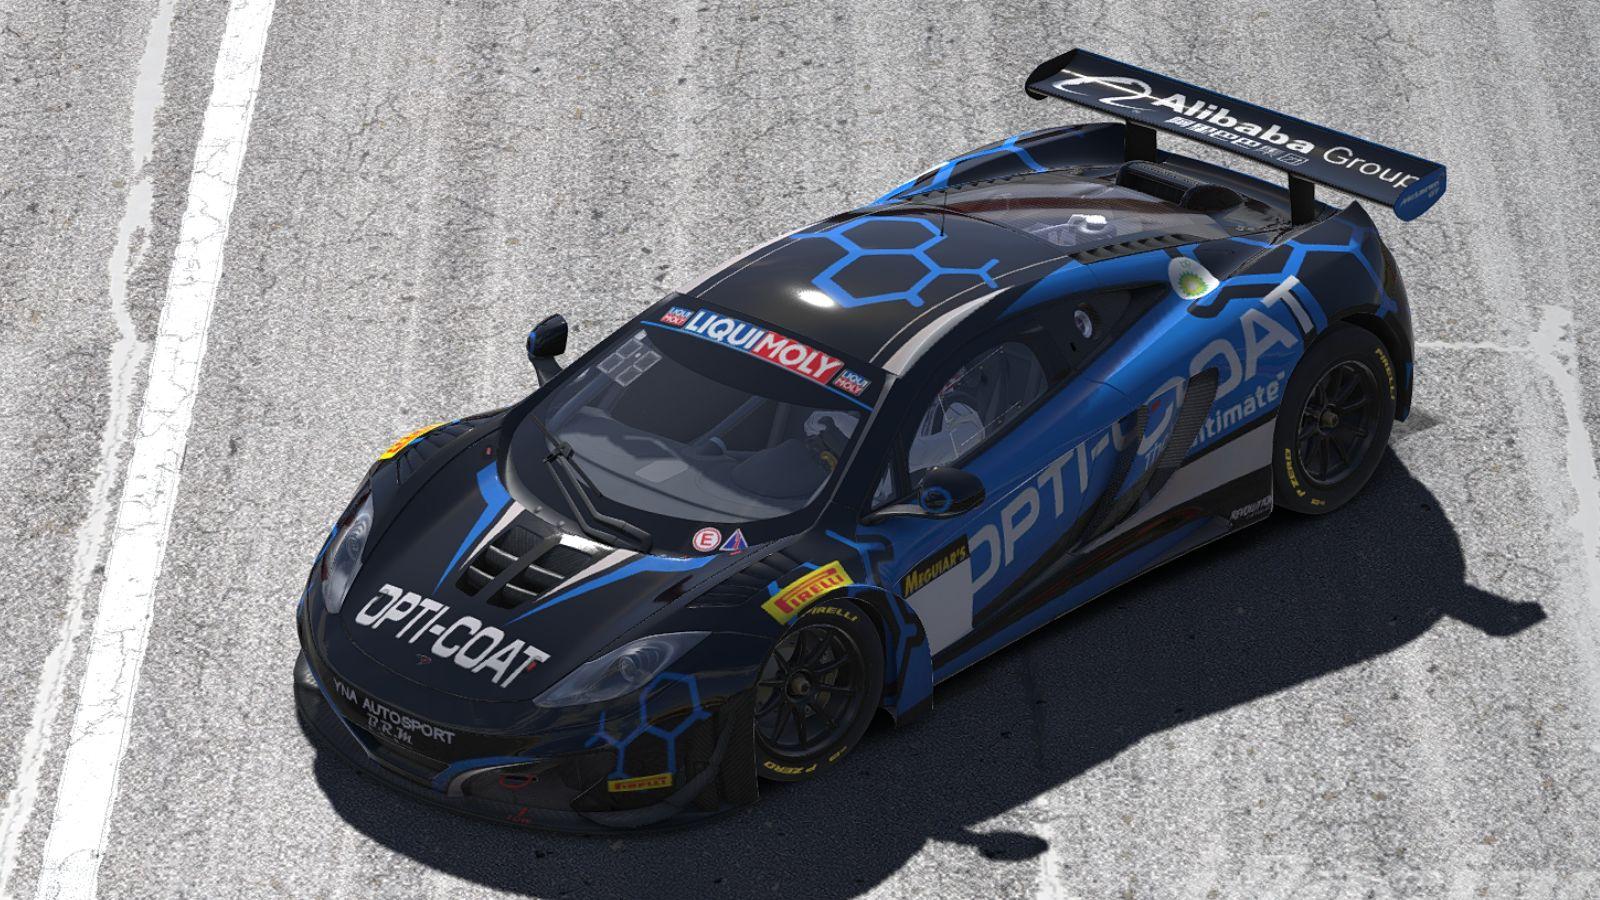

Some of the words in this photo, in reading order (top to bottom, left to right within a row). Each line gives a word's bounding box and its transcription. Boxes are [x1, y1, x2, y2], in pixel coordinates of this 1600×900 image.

[1152, 93, 1315, 155] Alibaba
[1323, 146, 1420, 189] Group
[685, 310, 761, 350] LIQUI
[752, 331, 845, 380] MOLY
[1375, 347, 1396, 401] PIRELLI
[774, 566, 845, 614] PIRELLI
[355, 583, 551, 688] OPTI-COAT
[333, 677, 359, 704] YNA
[362, 697, 456, 745] AUTOSPORT
